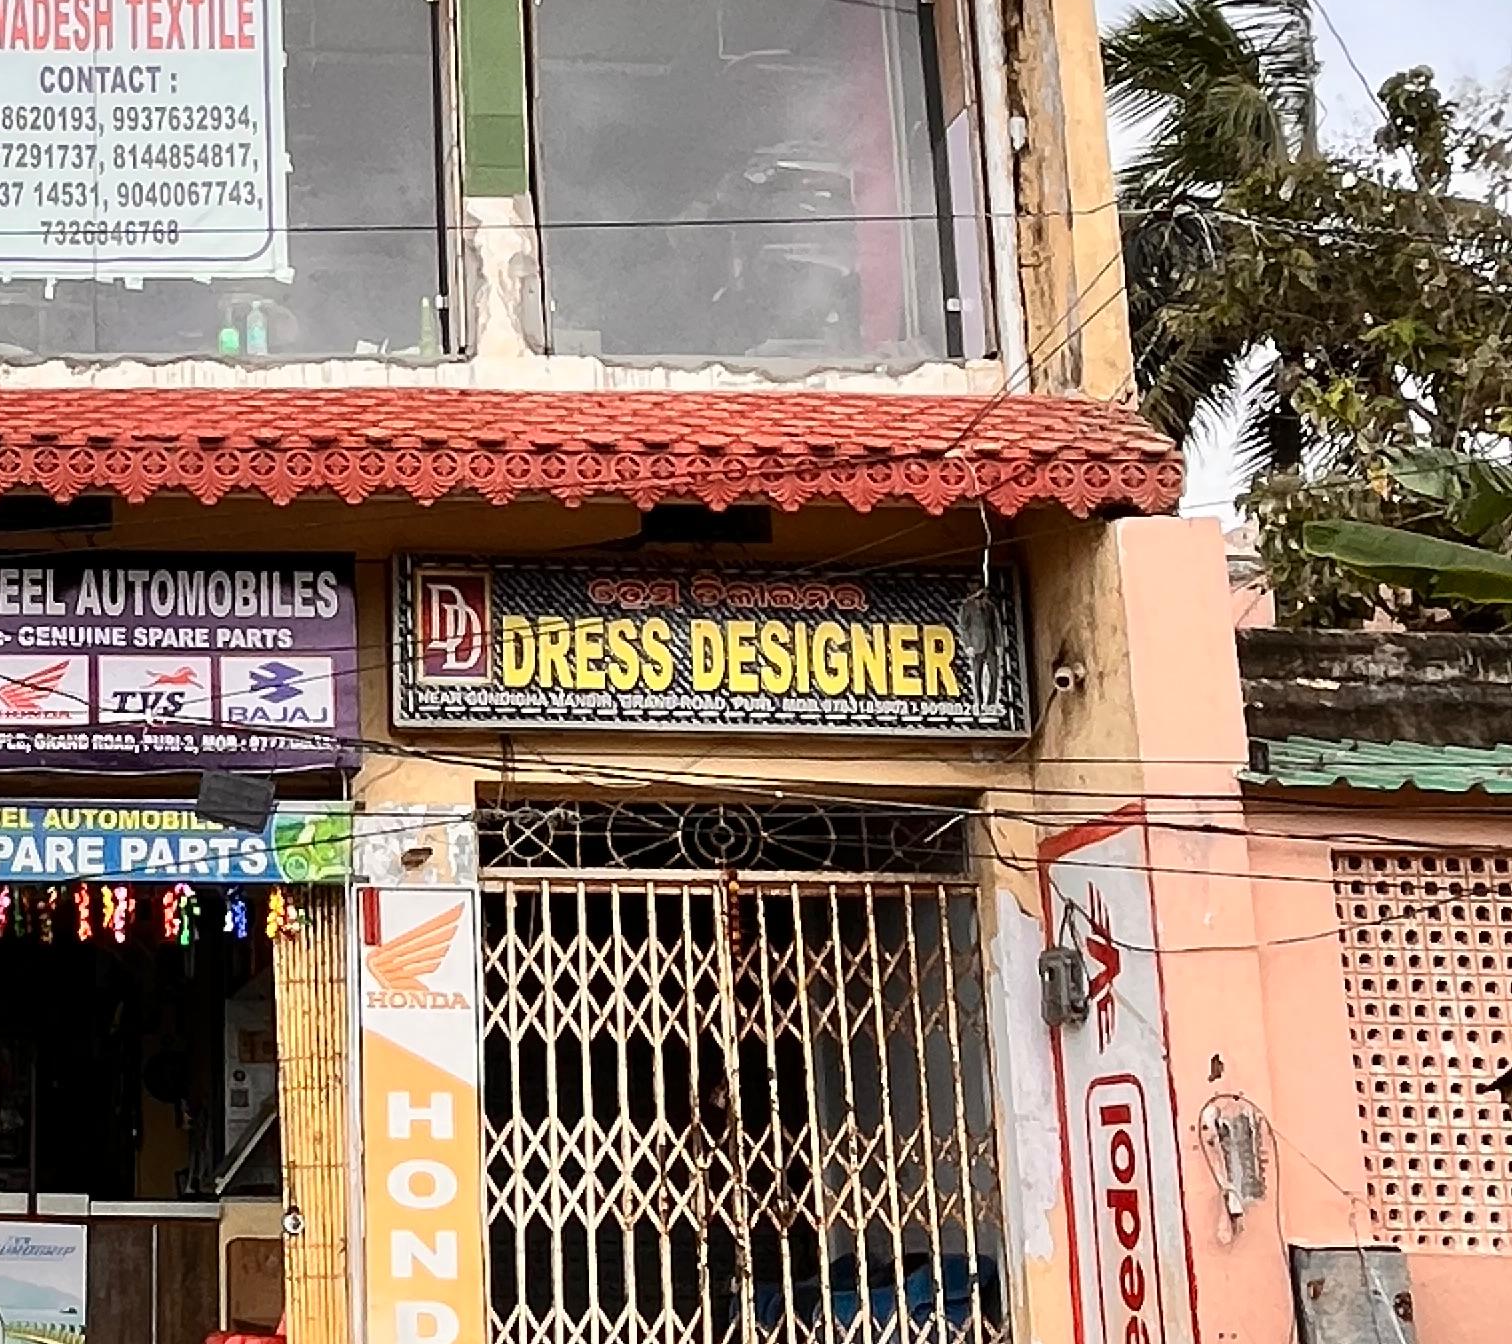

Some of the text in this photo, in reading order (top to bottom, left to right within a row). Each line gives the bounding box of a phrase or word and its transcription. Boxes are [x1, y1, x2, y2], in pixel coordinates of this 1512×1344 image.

[40, 66, 162, 94] CONTACT
[112, 105, 258, 135] 9937632934,
[113, 143, 259, 172] 8144854817,
[33, 181, 108, 212] 14531,
[116, 181, 263, 211] 9040067743,
[76, 570, 339, 619] AUTOMOBILES
[19, 626, 128, 648] GENUINE
[134, 627, 209, 648] SPARE
[216, 628, 293, 649] PARTS
[502, 615, 959, 696] DRESS DESIGNER
[112, 690, 186, 716] TVS
[228, 705, 328, 724] BAJAJ
[418, 691, 463, 705] NEAR
[34, 734, 89, 750] GRAND
[92, 735, 139, 753] ROAD,
[121, 837, 267, 875] PARTS
[366, 991, 472, 1010] HONDA
